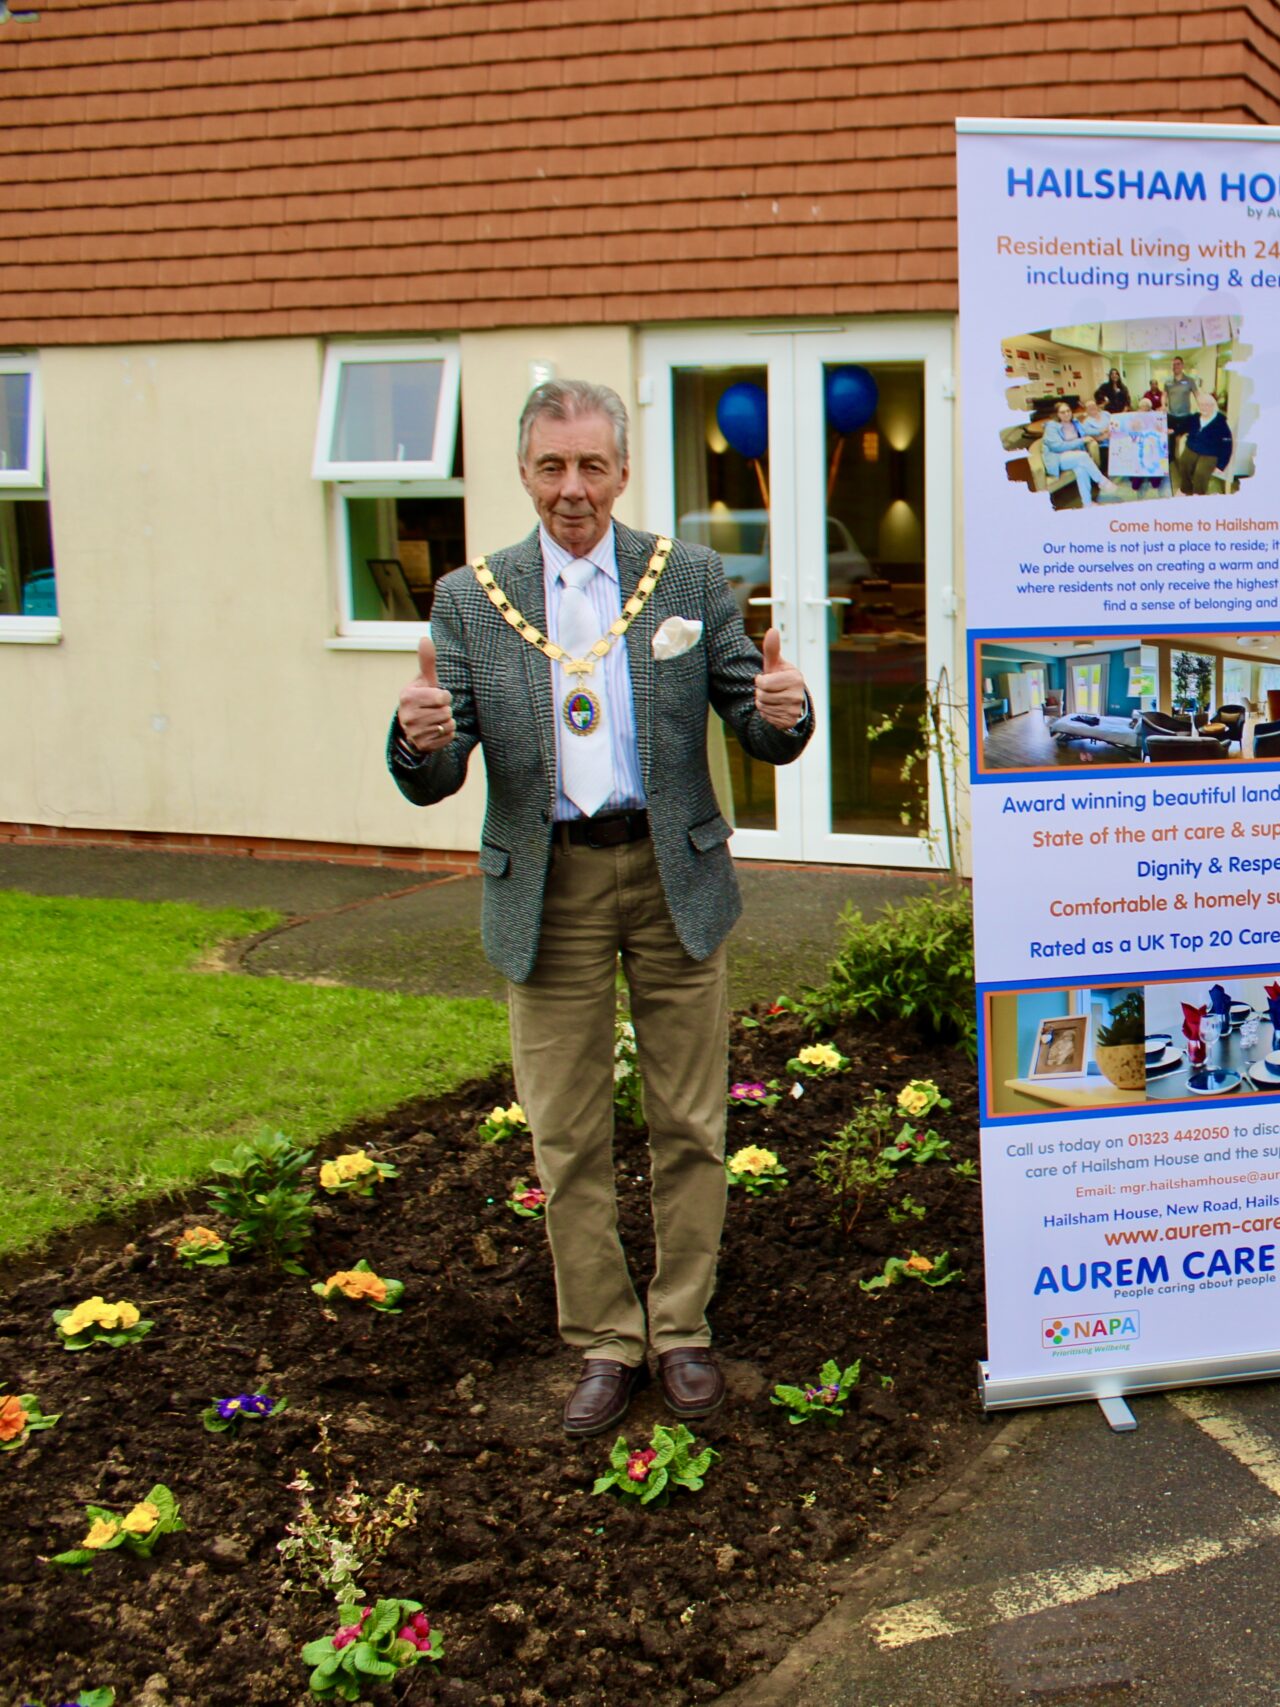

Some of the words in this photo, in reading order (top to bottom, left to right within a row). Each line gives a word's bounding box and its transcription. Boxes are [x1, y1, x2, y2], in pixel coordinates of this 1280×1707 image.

[1007, 167, 1206, 201] HAILSHAM
[1247, 205, 1262, 220] by
[997, 236, 1123, 256] Residential
[1131, 238, 1190, 262] living
[1198, 239, 1246, 258] with
[1027, 266, 1128, 289] including
[1137, 268, 1218, 291] nursing
[1227, 268, 1242, 287] &
[1109, 520, 1149, 532] Come
[1154, 519, 1193, 532] home
[1197, 519, 1211, 531] to
[1215, 518, 1278, 531] Hailsham
[1043, 542, 1066, 554] Our
[1069, 542, 1104, 553] home
[1107, 541, 1116, 552] is
[1120, 542, 1139, 552] not
[1143, 541, 1164, 555] just
[1167, 543, 1175, 551] a
[1179, 540, 1211, 554] place
[1214, 541, 1226, 551] to
[1019, 563, 1039, 573] We
[1043, 561, 1075, 576] pride
[1078, 561, 1134, 573] ourselves
[1137, 563, 1152, 571] on
[1156, 559, 1204, 573] creating
[1208, 562, 1216, 570] a
[1219, 561, 1253, 570] warm
[1256, 558, 1278, 569] and
[1016, 582, 1055, 593] where
[1058, 581, 1113, 592] residents
[1117, 581, 1136, 591] not
[1140, 579, 1164, 593] only
[1168, 579, 1210, 590] receive
[1213, 578, 1232, 589] the
[1236, 578, 1278, 592] highest
[1103, 599, 1126, 611] find
[1130, 602, 1137, 610] a
[1141, 601, 1175, 610] sense
[1178, 598, 1191, 609] of
[1194, 597, 1252, 611] belonging
[1255, 596, 1278, 608] and
[1002, 793, 1065, 813] Award
[1071, 791, 1145, 812] winning
[1153, 786, 1235, 806] beautiful
[1033, 830, 1083, 847] State
[1089, 826, 1109, 844] of
[1114, 826, 1145, 843] the
[1151, 825, 1178, 841] art
[1184, 826, 1224, 840] care
[1231, 821, 1245, 838] &
[1137, 858, 1202, 880] Dignity
[1208, 857, 1222, 873] &
[1050, 894, 1167, 917] Comfortable
[1173, 893, 1187, 910] &
[1194, 889, 1261, 910] homely
[1030, 938, 1085, 958] Rated
[1092, 941, 1113, 954] as
[1119, 940, 1130, 952] a
[1138, 934, 1164, 951] UK
[1169, 933, 1203, 952] Top
[1209, 930, 1232, 946] 20
[1239, 928, 1280, 944] Care
[1006, 1142, 1033, 1157] Call
[1038, 1144, 1054, 1154] us
[1058, 1138, 1100, 1153] today
[1105, 1138, 1123, 1148] on
[1128, 1131, 1169, 1146] 01323
[1173, 1126, 1229, 1142] 442050
[1233, 1126, 1248, 1137] to
[1025, 1166, 1057, 1178] care
[1062, 1161, 1077, 1174] of
[1081, 1157, 1149, 1173] Hailsham
[1154, 1154, 1199, 1166] House
[1203, 1147, 1230, 1162] and
[1235, 1146, 1258, 1159] the
[1076, 1184, 1115, 1197] Email:
[1044, 1212, 1109, 1227] Hailsham
[1114, 1208, 1162, 1221] House,
[1166, 1204, 1198, 1216] New
[1203, 1197, 1241, 1212] Road,
[1034, 1255, 1169, 1295] AUREM
[1182, 1244, 1275, 1279] CARE
[1114, 1286, 1154, 1298] People
[1158, 1284, 1195, 1294] caring
[1199, 1278, 1233, 1290] about
[1236, 1273, 1276, 1288] people
[1074, 1317, 1136, 1338] NAPA
